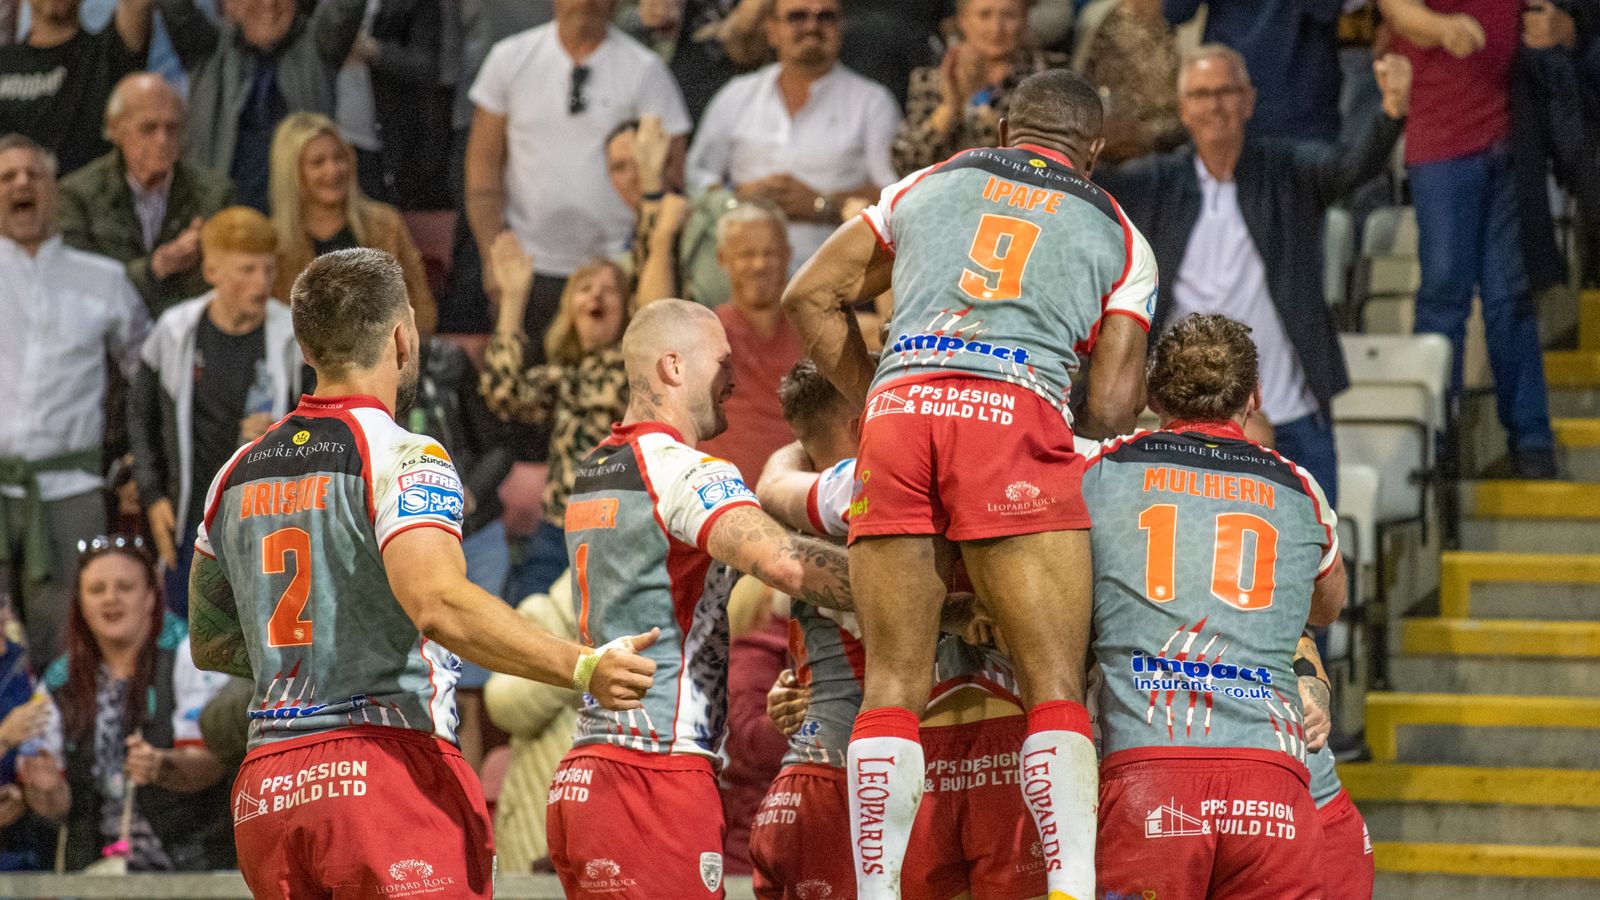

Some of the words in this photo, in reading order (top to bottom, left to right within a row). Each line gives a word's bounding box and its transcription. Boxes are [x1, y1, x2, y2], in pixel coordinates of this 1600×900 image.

[969, 150, 1030, 174] LEISURE
[1034, 167, 1099, 195] RESORTS
[981, 176, 1066, 215] IPAPE
[958, 213, 1042, 301] 9
[893, 333, 1031, 365] impact
[908, 384, 943, 400] PPS
[947, 387, 1016, 411] DESIGN
[903, 400, 916, 414] &
[920, 400, 974, 418] BUILD
[978, 407, 1014, 426] LTD
[246, 444, 294, 465] LEISURE
[295, 442, 346, 459] RESORTS
[1145, 442, 1207, 457] LEISURE
[1211, 448, 1277, 467] RESORTS
[430, 492, 462, 512] SUPE
[1143, 467, 1275, 510] MULHERN
[987, 502, 1031, 512] LEOPARD
[1032, 496, 1057, 508] ROCK
[1138, 503, 1279, 611] 10
[261, 526, 312, 647] 2
[575, 542, 594, 646] 1
[1131, 649, 1273, 684] impact
[260, 770, 293, 796] PPS
[296, 760, 368, 788] DESIGN
[925, 760, 957, 776] PPS
[960, 751, 1022, 774] DESIGN
[564, 785, 589, 803] LTD
[923, 779, 935, 793] &
[940, 772, 986, 792] BUILD
[258, 799, 269, 816] &
[273, 783, 323, 813] BUILD
[328, 780, 367, 798] LTD
[1023, 746, 1063, 873] LEOPARDS
[1201, 800, 1228, 816] PPS
[1232, 799, 1295, 823] DESIGN
[772, 809, 797, 825] LTD
[857, 755, 896, 876] LEOPARDS
[1202, 821, 1212, 835] &
[1265, 821, 1296, 841] LTD
[375, 881, 421, 895] LEOPARD
[423, 876, 455, 888] ROCK
